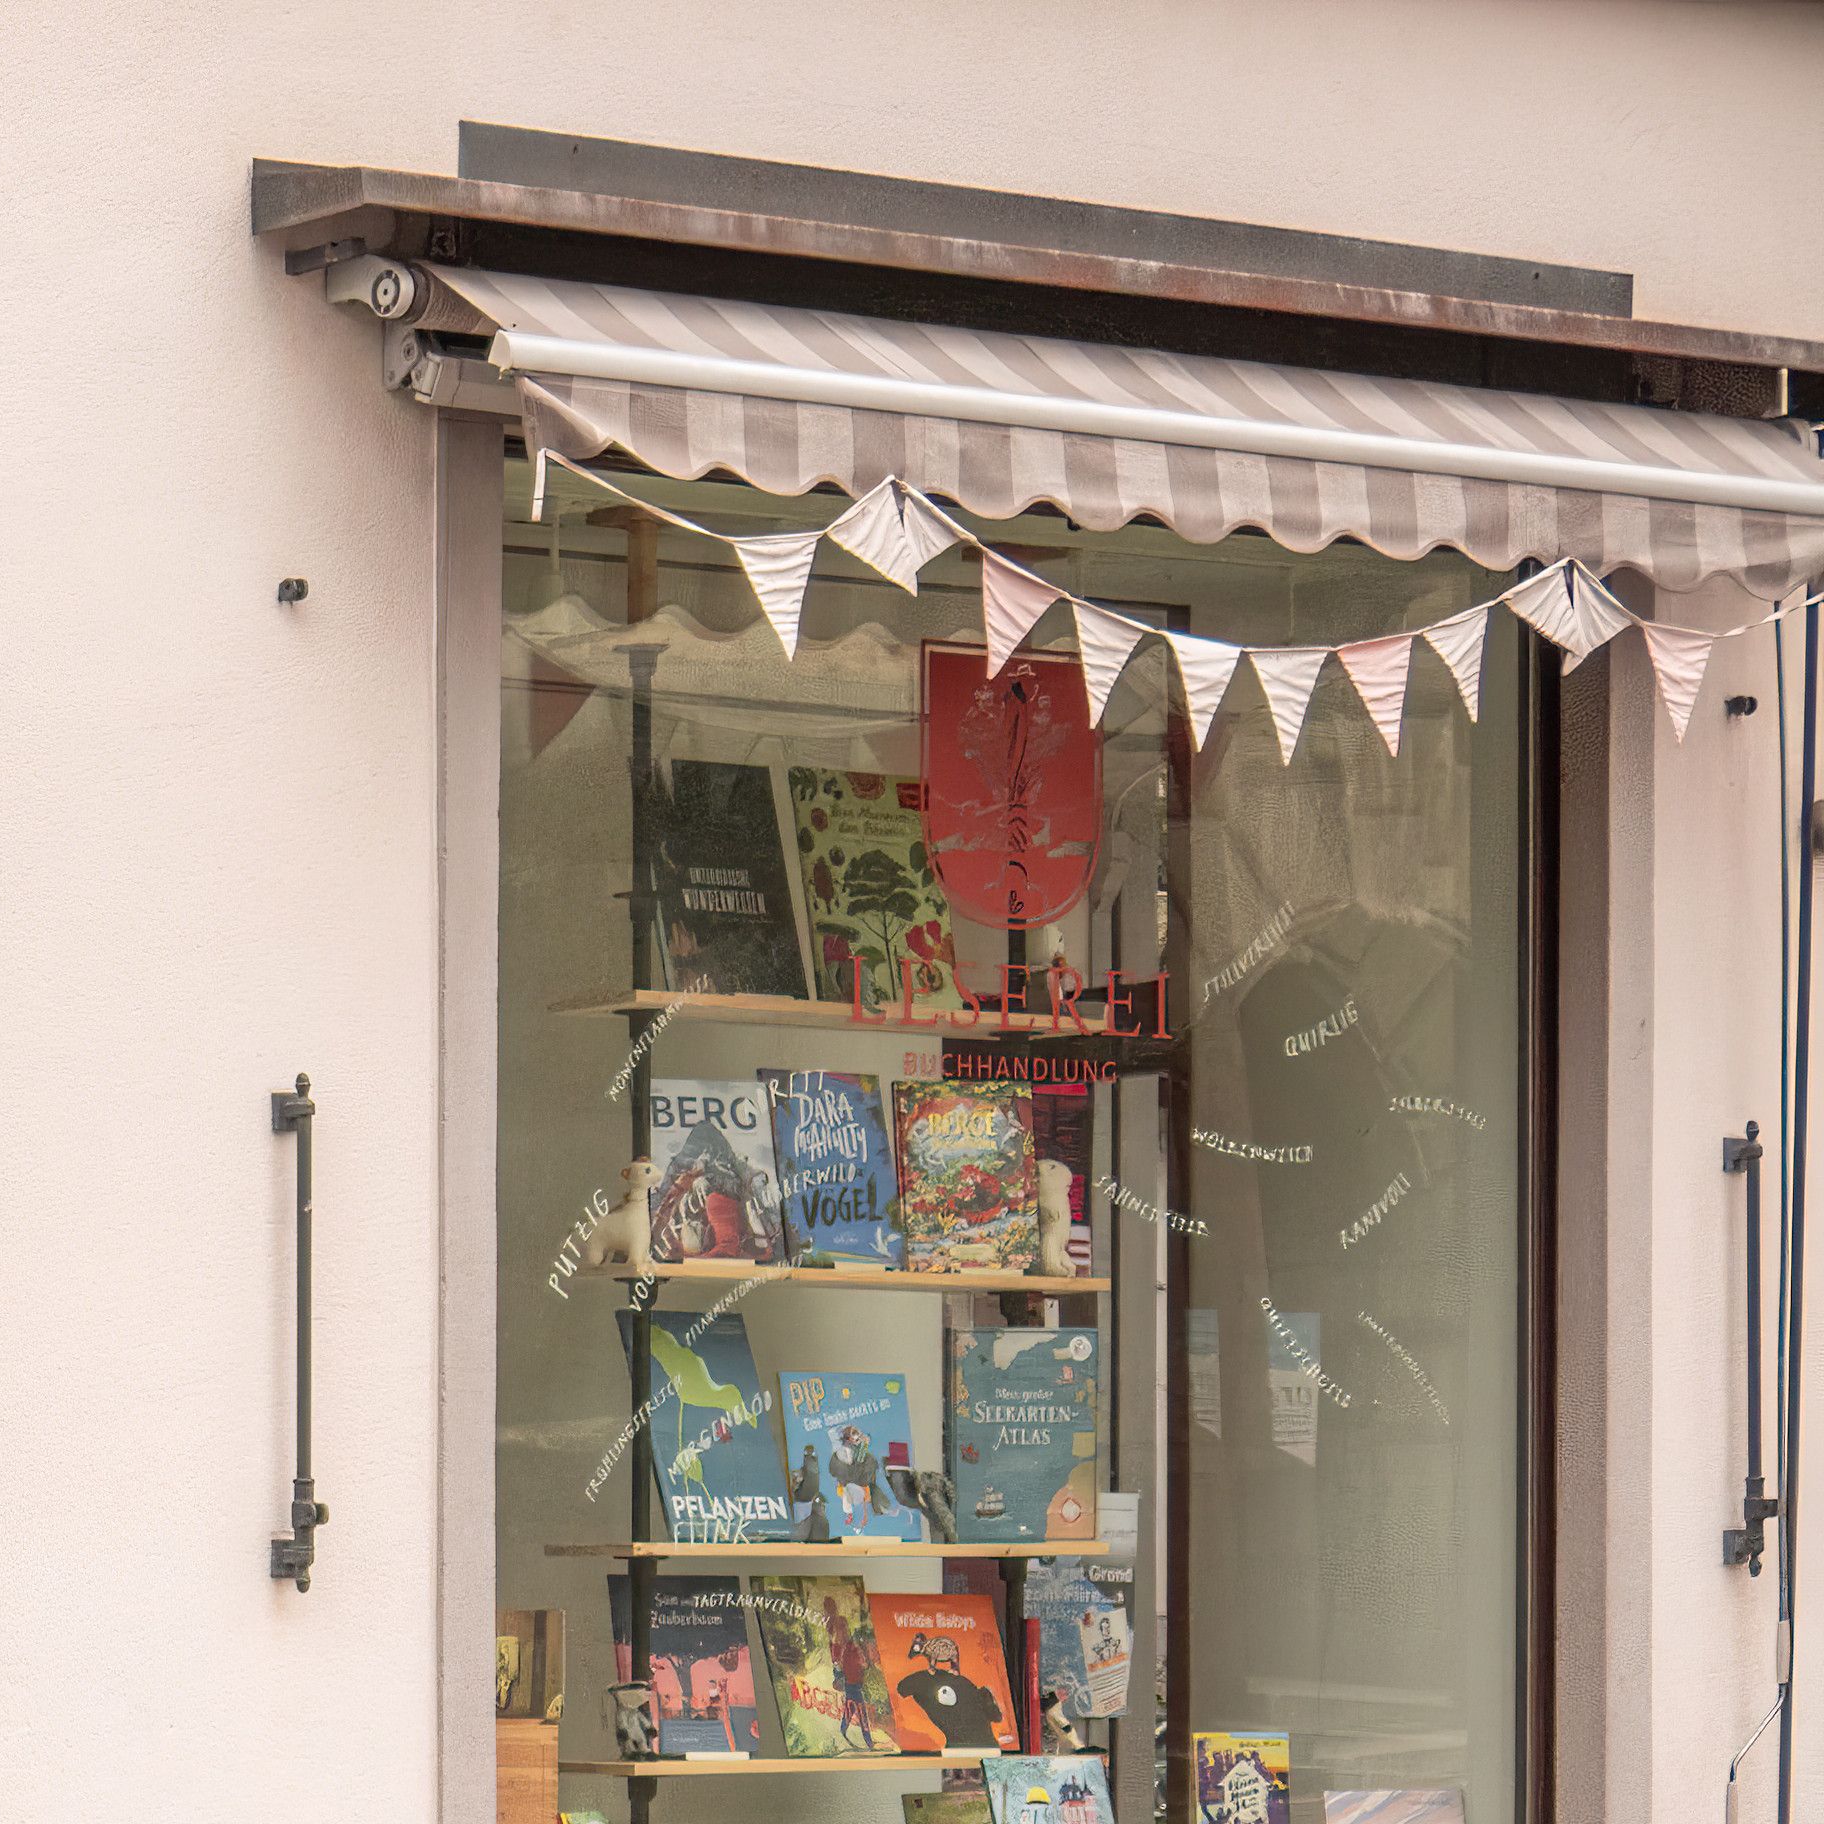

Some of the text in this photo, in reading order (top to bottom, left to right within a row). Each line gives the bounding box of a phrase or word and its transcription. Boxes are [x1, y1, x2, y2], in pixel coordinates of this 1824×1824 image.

[847, 955, 1173, 1040] LESEREI
[903, 1052, 1119, 1083] BUCHHANDLUNG
[651, 1095, 757, 1131] BERG
[548, 1188, 610, 1300] PUTZIG
[790, 1376, 824, 1415] PIP
[992, 1425, 1051, 1452] ATLAS
[671, 1495, 788, 1521] PFLANZEN
